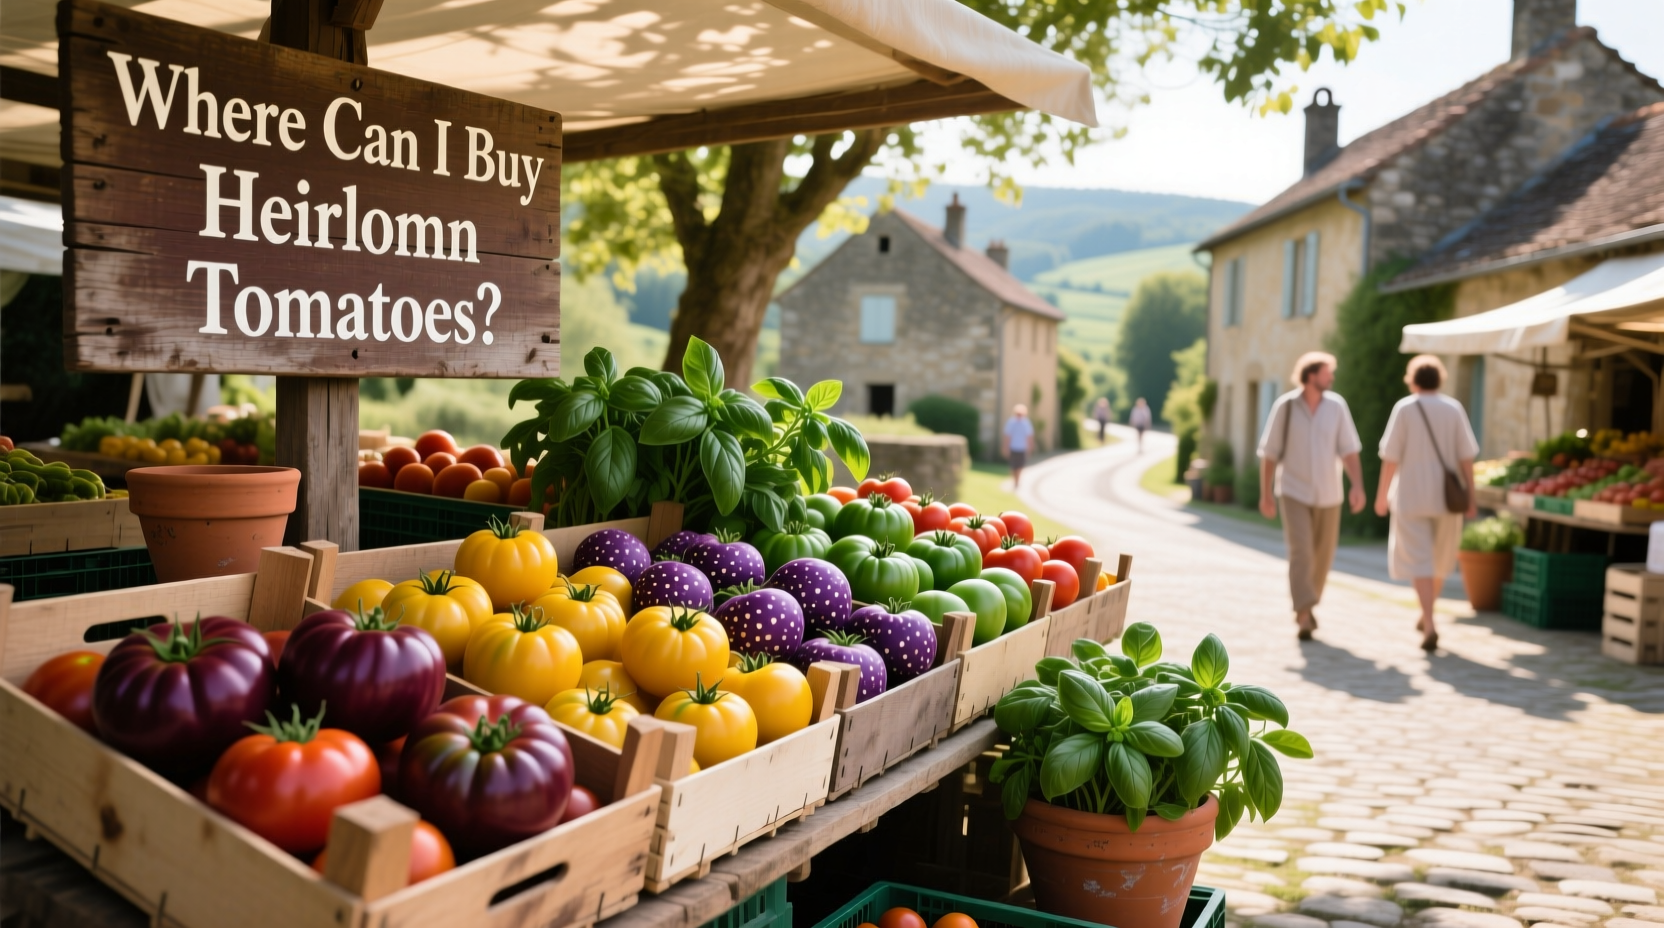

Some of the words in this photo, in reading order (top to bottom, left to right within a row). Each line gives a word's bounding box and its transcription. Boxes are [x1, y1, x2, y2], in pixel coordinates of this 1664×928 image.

[107, 51, 306, 151] Where
[323, 97, 421, 172] Can
[433, 119, 452, 177] I
[463, 125, 545, 206] Buy
[198, 163, 481, 264] Heirlomn
[186, 259, 502, 345] Tomatoes?
